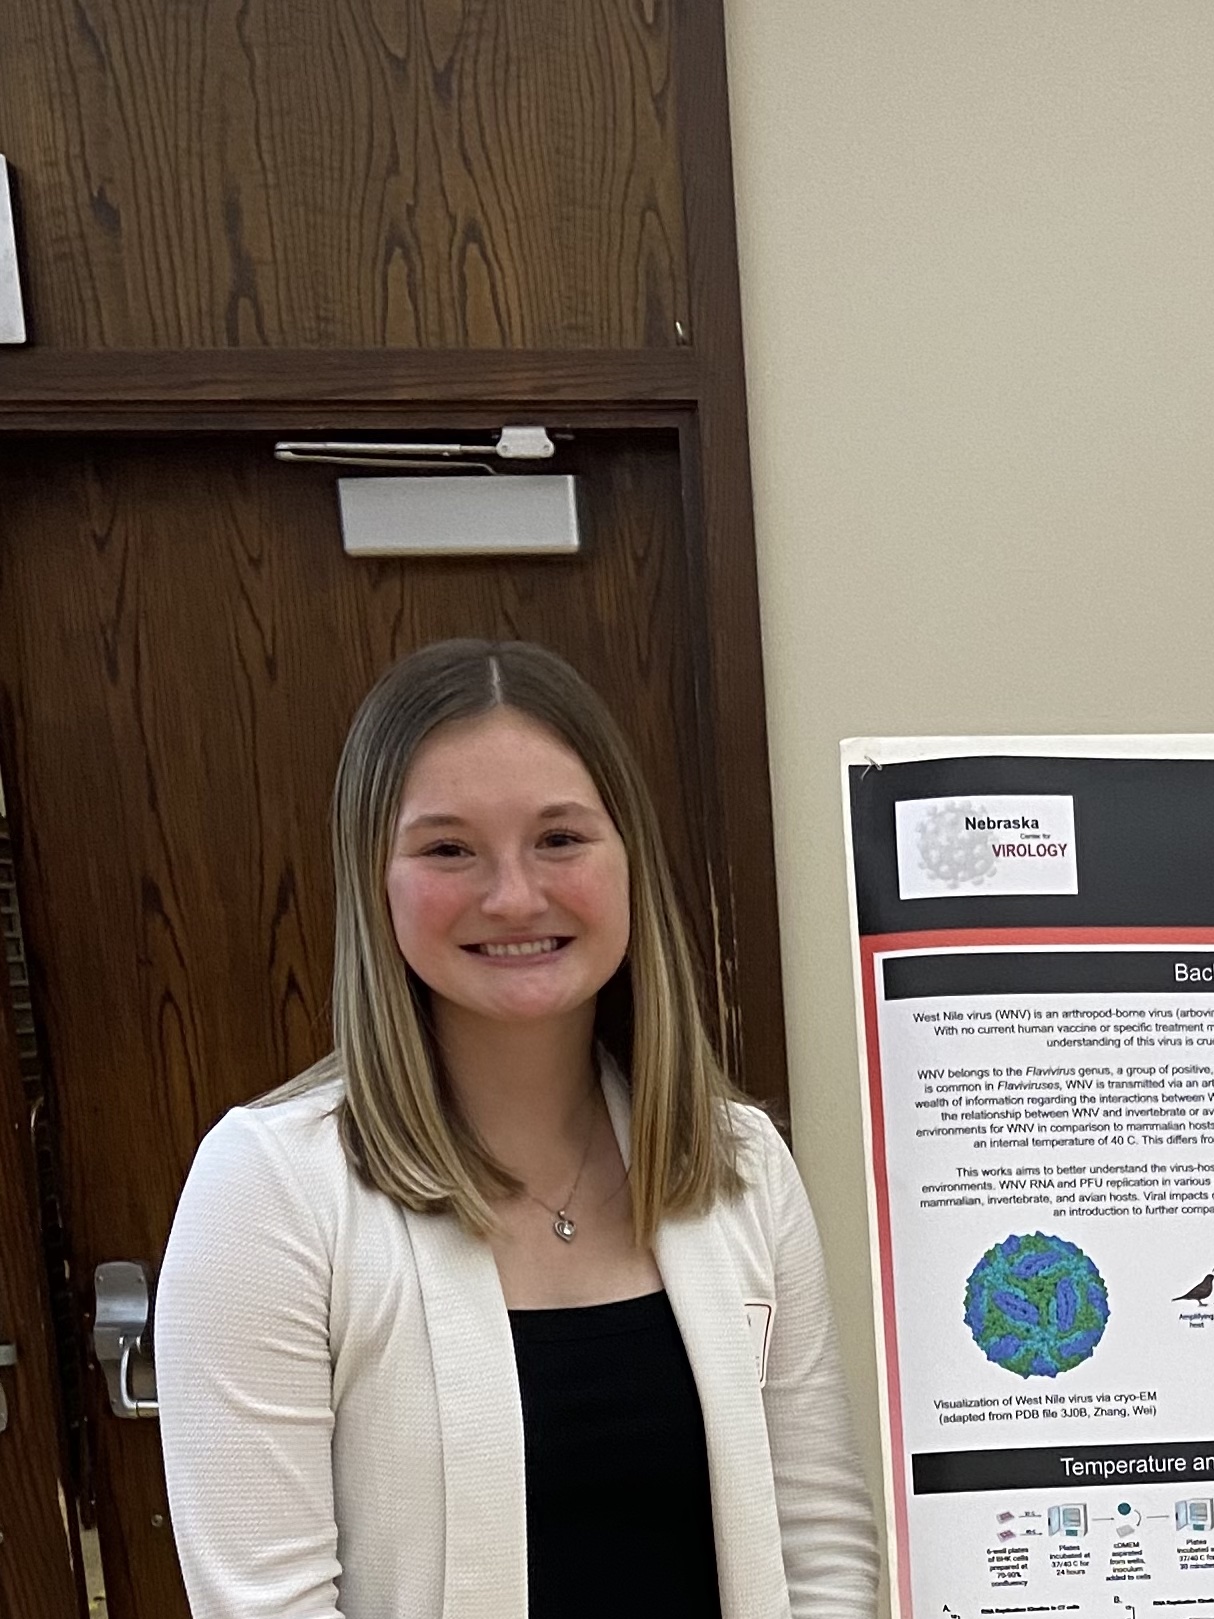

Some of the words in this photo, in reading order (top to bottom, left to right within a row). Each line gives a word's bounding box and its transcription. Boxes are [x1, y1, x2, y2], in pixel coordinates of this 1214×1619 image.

[964, 816, 1039, 830] Nebraska
[991, 843, 1067, 857] VIROLOGY
[933, 1398, 999, 1409] Visualization
[1001, 1395, 1012, 1406] of
[1015, 1395, 1042, 1405] West
[1044, 1394, 1065, 1404] Nile
[1068, 1394, 1093, 1403] virus
[1095, 1393, 1110, 1402] via
[1113, 1391, 1156, 1404] cryo-EM
[938, 1412, 985, 1425] (adapted
[988, 1411, 1012, 1420] from
[1015, 1409, 1039, 1419] PDB
[1042, 1408, 1058, 1418] file
[1093, 1405, 1130, 1418] Zhang,
[1132, 1405, 1156, 1416] Wei)
[1060, 1456, 1186, 1477] Temperature
